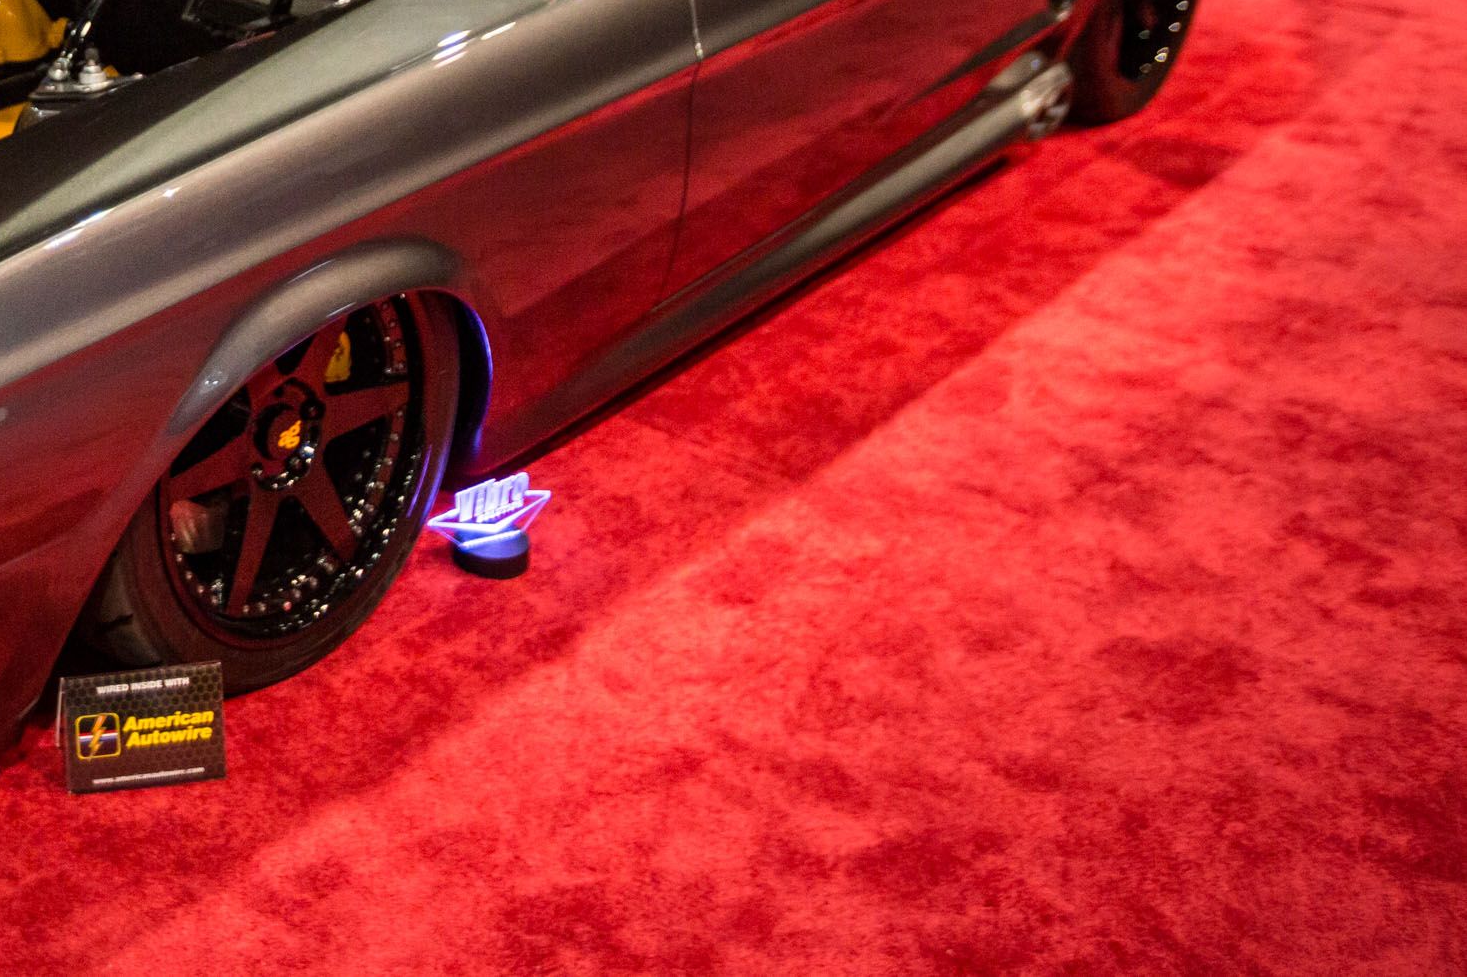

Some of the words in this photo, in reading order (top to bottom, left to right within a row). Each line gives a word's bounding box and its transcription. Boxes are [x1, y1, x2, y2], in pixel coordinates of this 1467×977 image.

[97, 684, 129, 694] WIRED
[131, 680, 163, 691] INSIDE
[164, 677, 190, 688] WITH
[123, 711, 214, 731] American
[126, 727, 212, 748] Autowire
